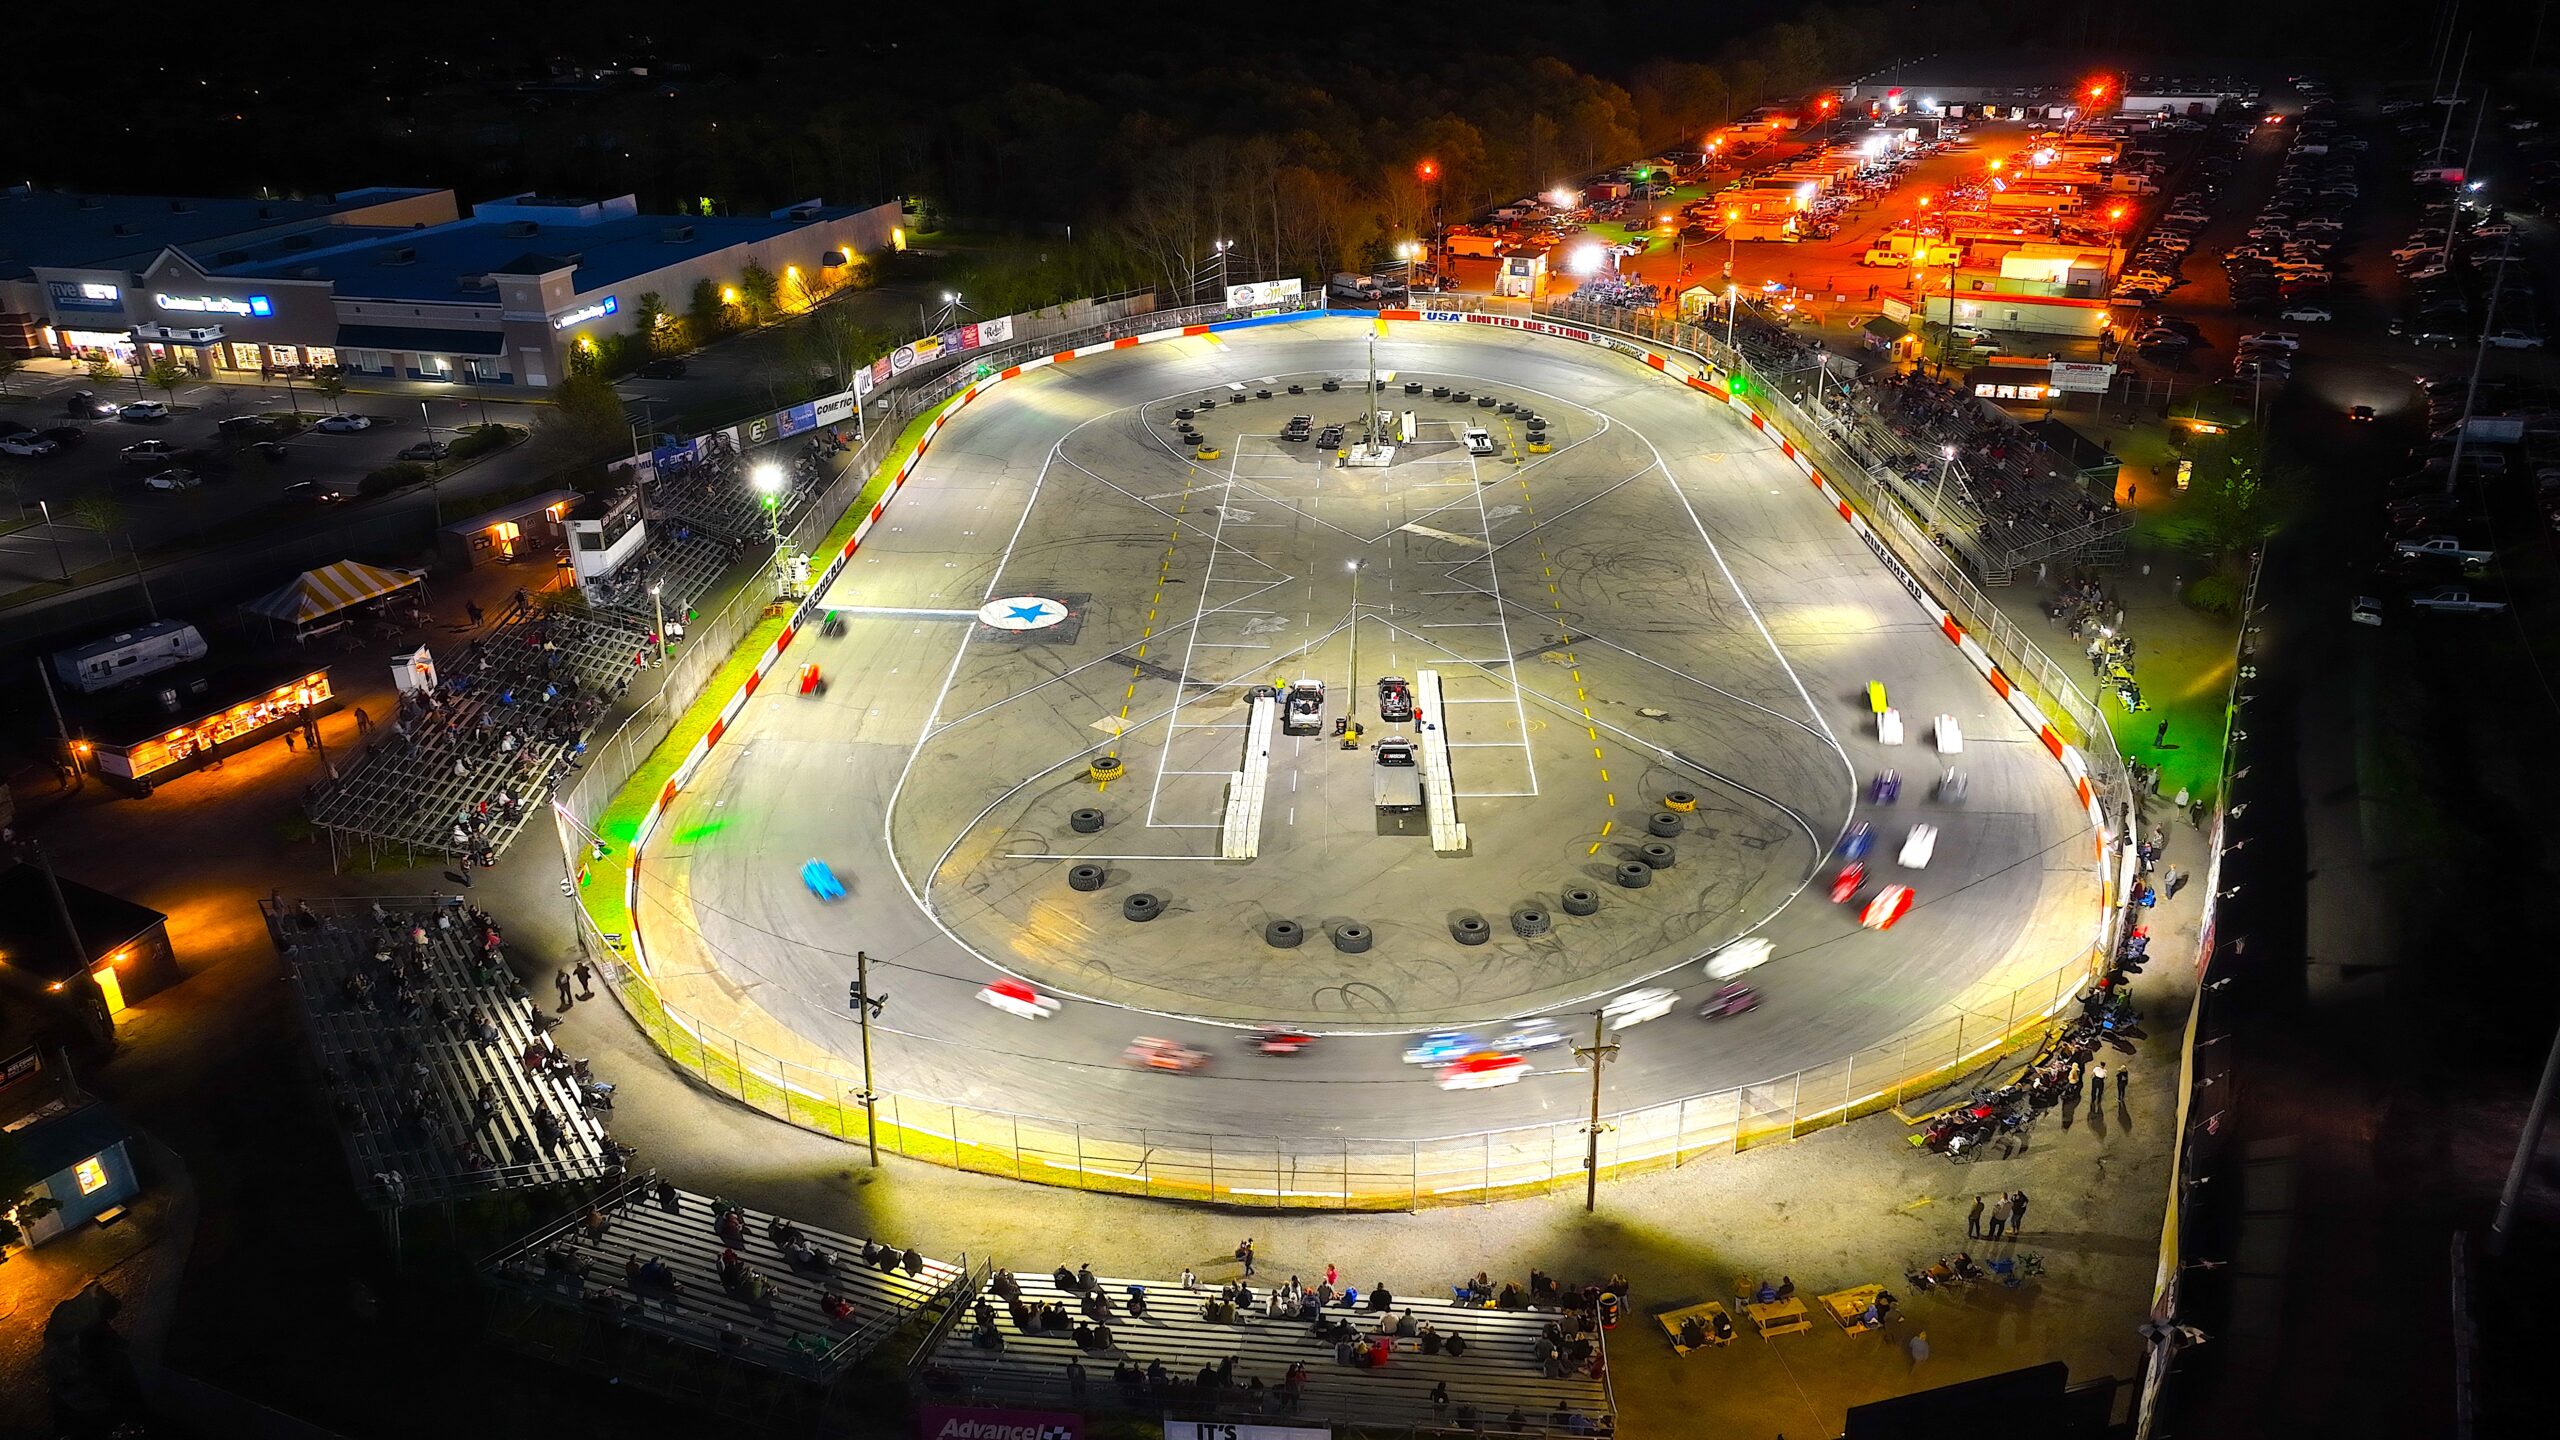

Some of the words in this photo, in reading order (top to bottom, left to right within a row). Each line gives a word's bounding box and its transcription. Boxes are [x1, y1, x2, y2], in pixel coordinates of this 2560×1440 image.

[49, 283, 76, 297] five
[1264, 282, 1298, 302] Miller
[1283, 293, 1300, 302] TIME
[1426, 312, 1460, 321] USA
[1466, 314, 1519, 328] UNITED
[1523, 320, 1546, 332] WE
[1548, 325, 1590, 341] STAND
[816, 397, 853, 416] COMETIC
[1864, 529, 1922, 600] RIVERHEAD
[793, 556, 842, 630] RIVERHEAD
[1196, 1423, 1237, 1440] IT'S
